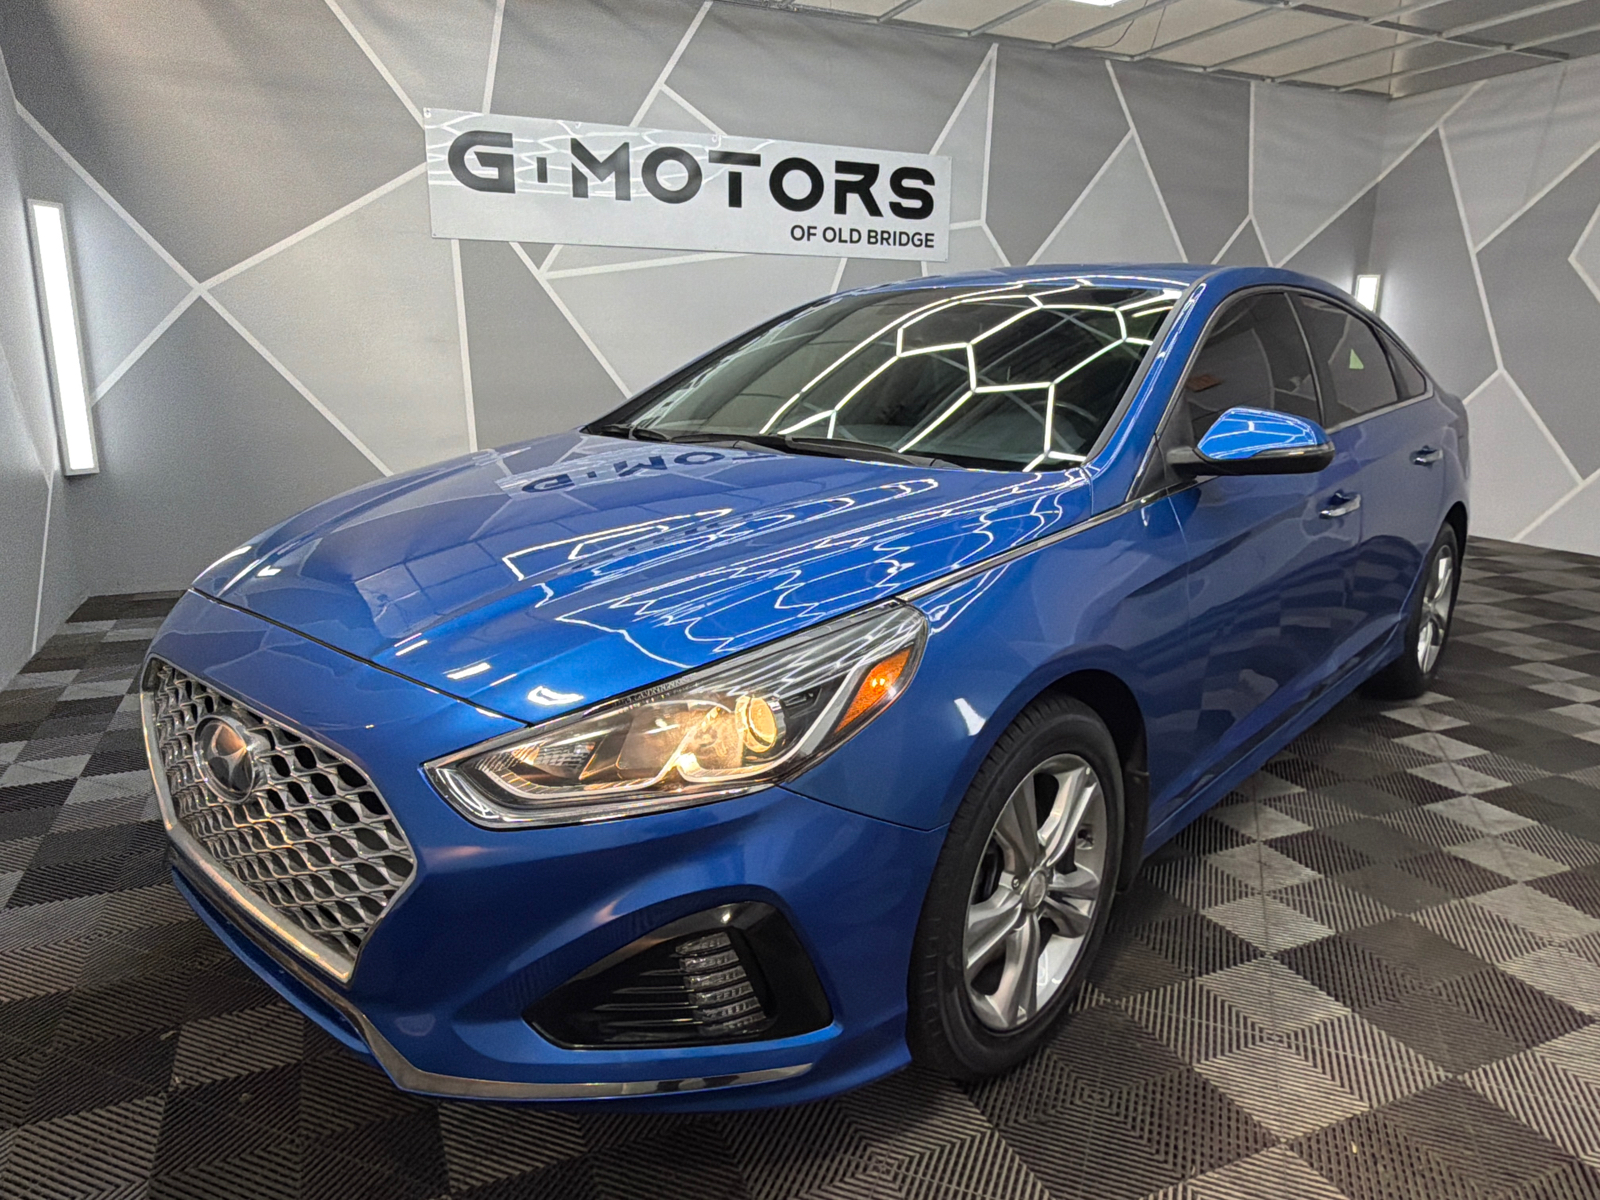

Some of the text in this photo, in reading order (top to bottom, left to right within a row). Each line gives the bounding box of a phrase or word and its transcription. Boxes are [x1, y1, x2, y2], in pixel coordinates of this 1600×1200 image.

[790, 224, 935, 248] OF OLD BRIDGE
